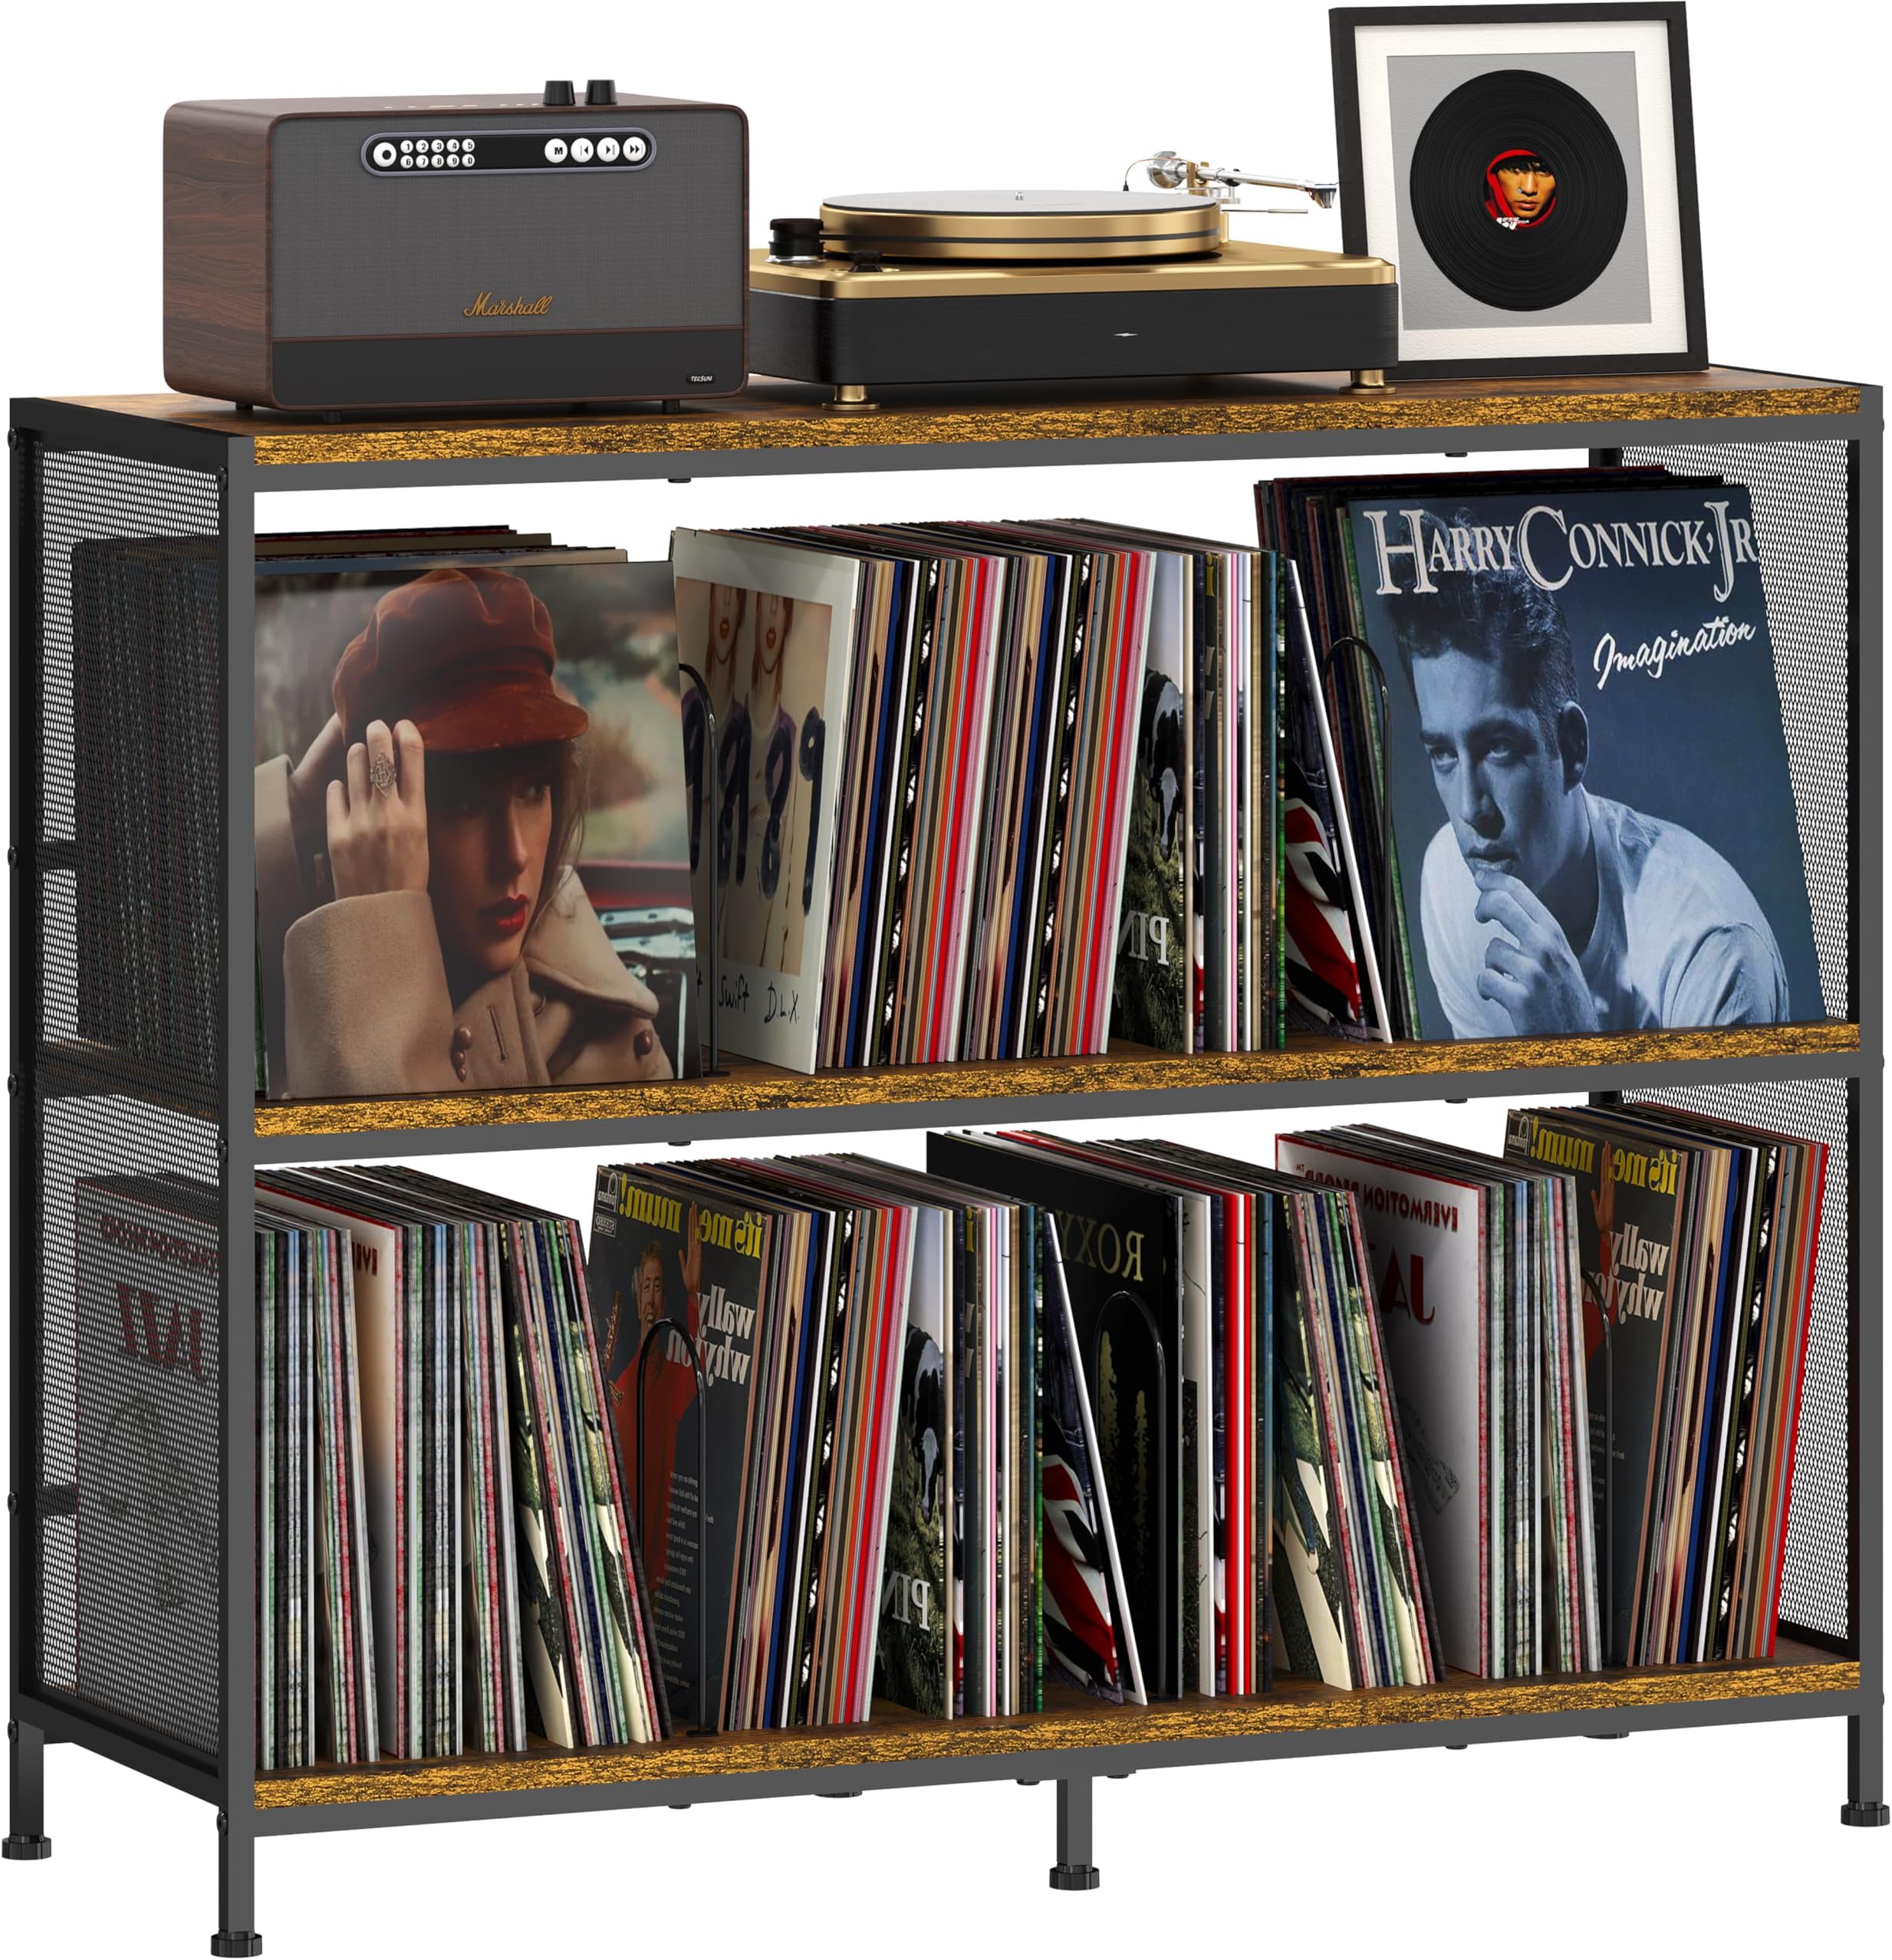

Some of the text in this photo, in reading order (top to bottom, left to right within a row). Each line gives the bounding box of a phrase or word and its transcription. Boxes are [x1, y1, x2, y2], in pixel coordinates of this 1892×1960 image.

[554, 146, 563, 155] M
[463, 291, 552, 316] Marshall
[1363, 508, 1515, 594] HARRY
[1594, 616, 1756, 690] Imagination
[719, 973, 749, 1012] Swift
